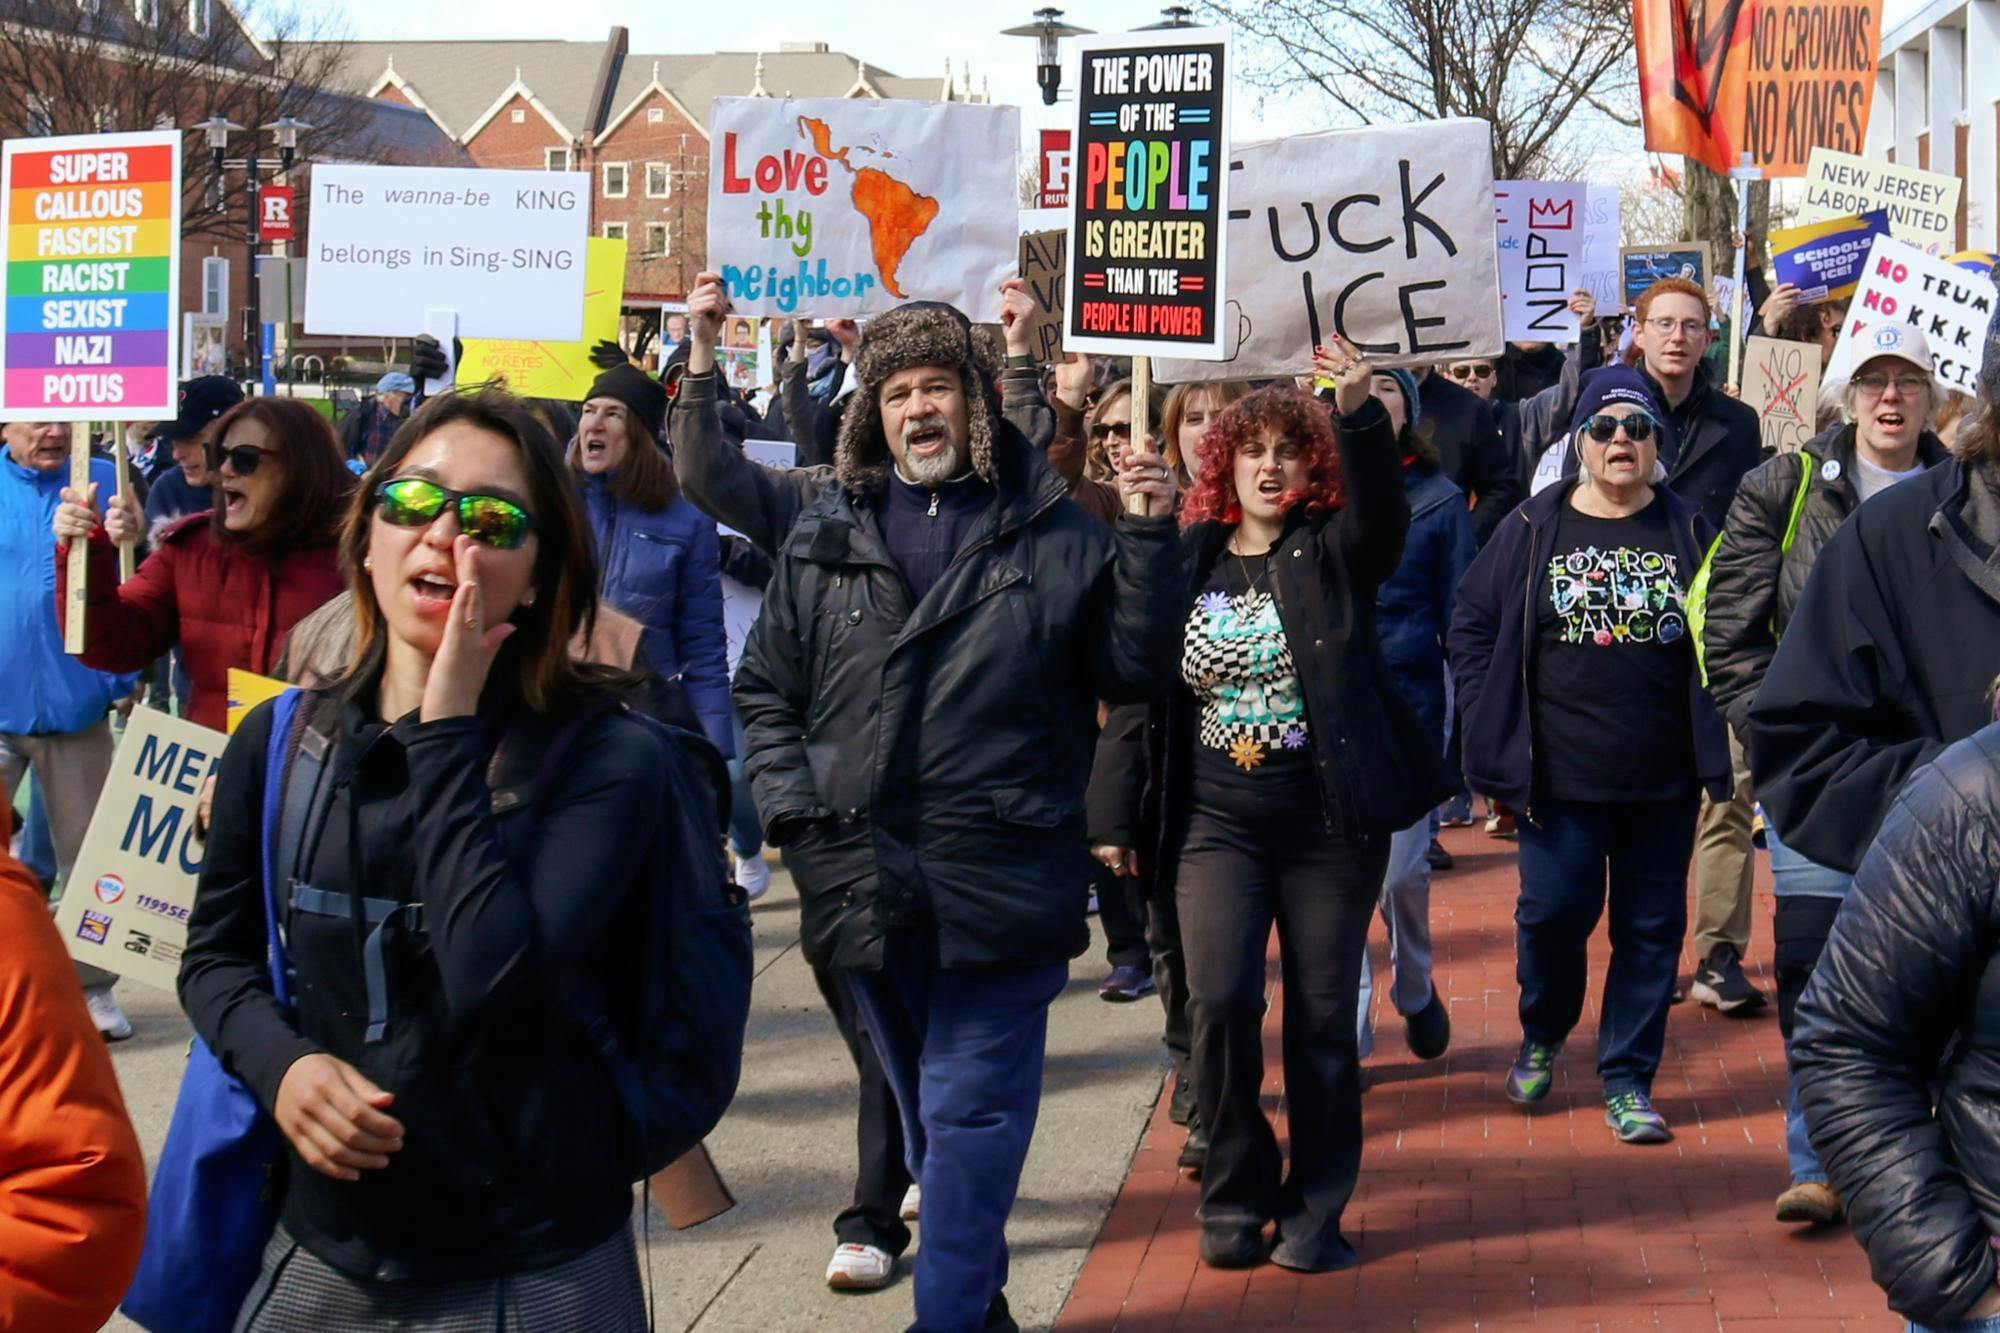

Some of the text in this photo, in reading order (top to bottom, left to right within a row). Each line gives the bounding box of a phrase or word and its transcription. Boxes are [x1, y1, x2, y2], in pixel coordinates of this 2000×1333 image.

[1749, 5, 1871, 72] NO CROWNS.
[1091, 53, 1213, 95] THE POWER
[1119, 102, 1176, 133] OF THE
[1744, 80, 1779, 165] NO
[49, 152, 128, 184] SUPER
[722, 131, 829, 196] Love
[1085, 140, 1210, 211] PEOPLE
[323, 183, 576, 211] The wanna-be KING
[1821, 162, 1946, 205] NEW JERSEY
[34, 188, 143, 220] CALLOUS
[264, 197, 289, 221] R
[1229, 159, 1458, 262] UCK
[1807, 186, 1869, 215] LABOR
[37, 225, 138, 257] FASCIST
[755, 198, 813, 257] thy
[1085, 219, 1205, 260] IS GREATER
[320, 243, 411, 268] belongs
[423, 246, 443, 266] in
[1793, 237, 1872, 264] SCHOOLS
[1811, 252, 1860, 273] DROP
[42, 261, 128, 293] RACIST
[721, 258, 875, 313] neighbor
[1106, 267, 1178, 296] THAN THE
[1821, 265, 1852, 282] ICE!
[1875, 256, 1908, 284] NO
[42, 298, 128, 329] SEXIST
[1303, 271, 1471, 354] ICE
[1862, 288, 1897, 316] NO
[1082, 302, 1203, 337] PEOPLE IN POWER
[54, 335, 113, 365] NAZI
[1769, 346, 1802, 381] NO
[42, 373, 124, 404] POTUS
[1552, 550, 1678, 578] FOXTROT
[1552, 570, 1686, 615] DELTA
[1559, 609, 1685, 645] TANGO
